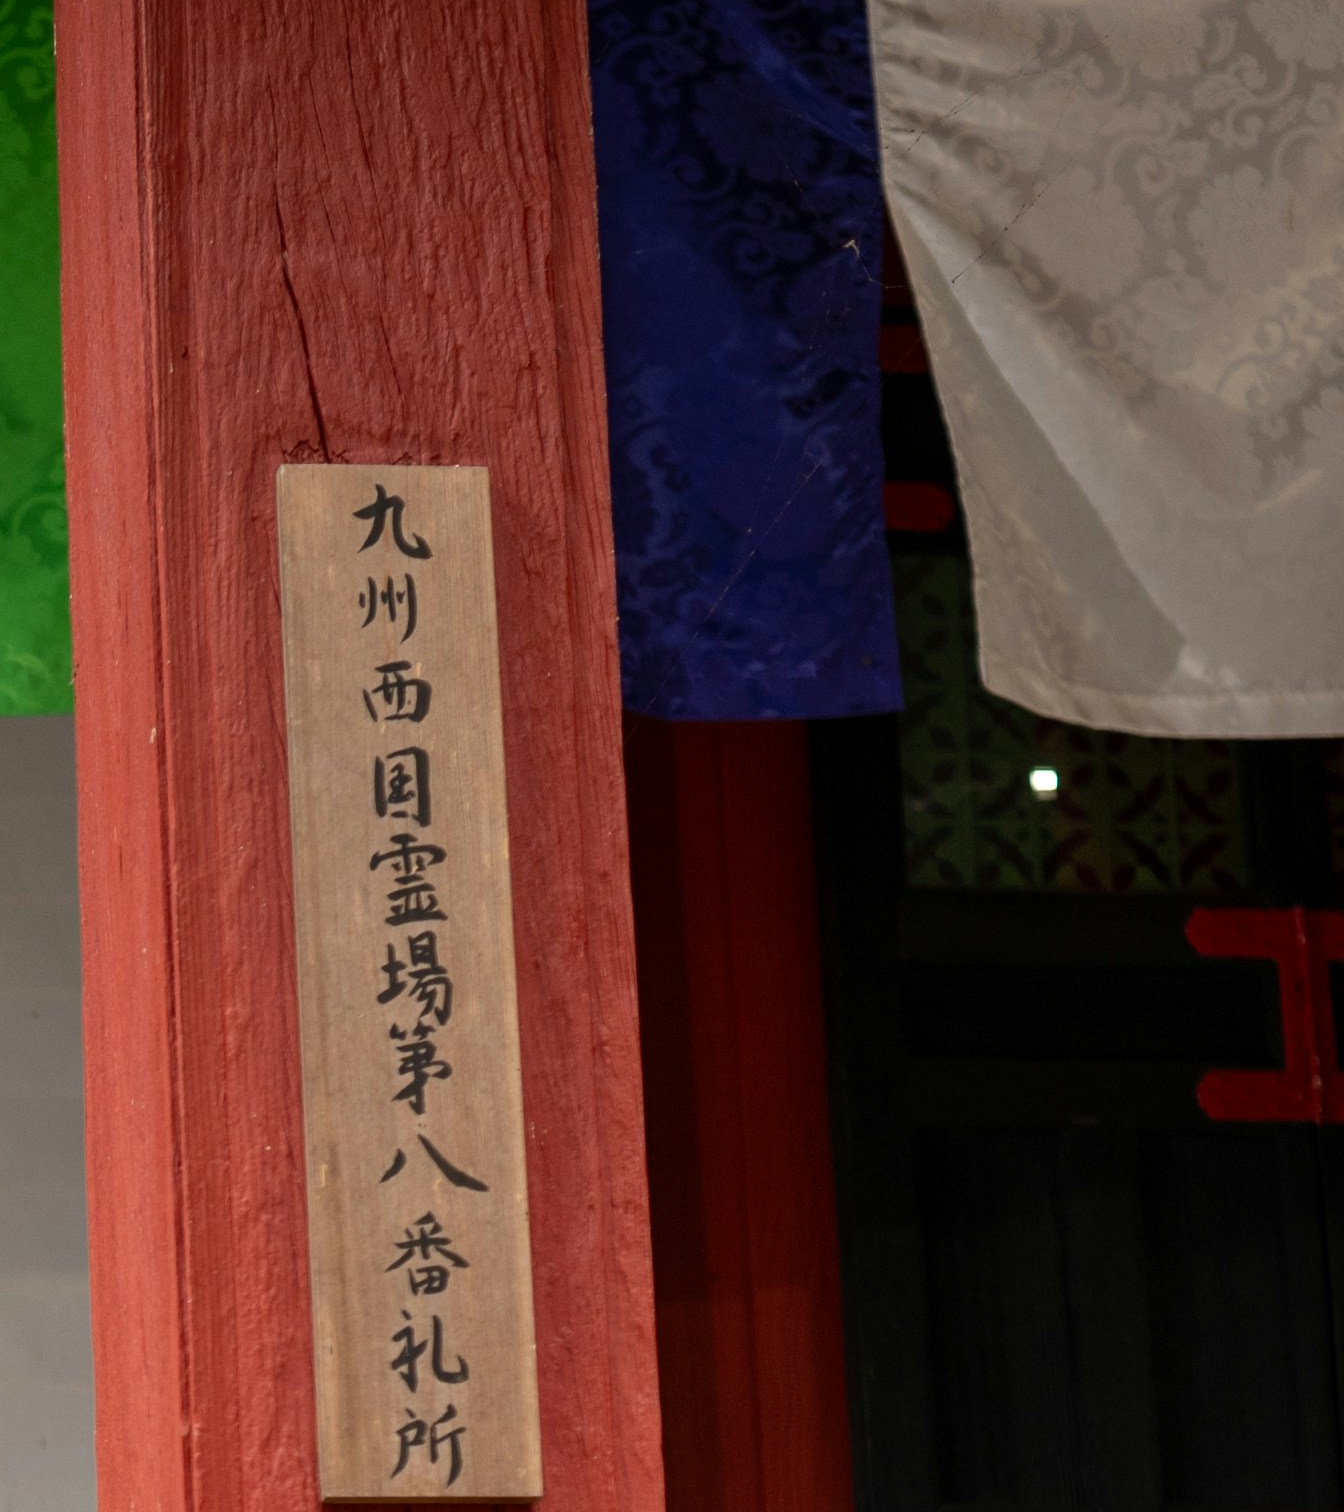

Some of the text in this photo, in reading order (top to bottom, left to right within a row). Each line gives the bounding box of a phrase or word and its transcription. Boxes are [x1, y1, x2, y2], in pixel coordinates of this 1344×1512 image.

[353, 483, 490, 1489] 九州西国霊場第八番札所
